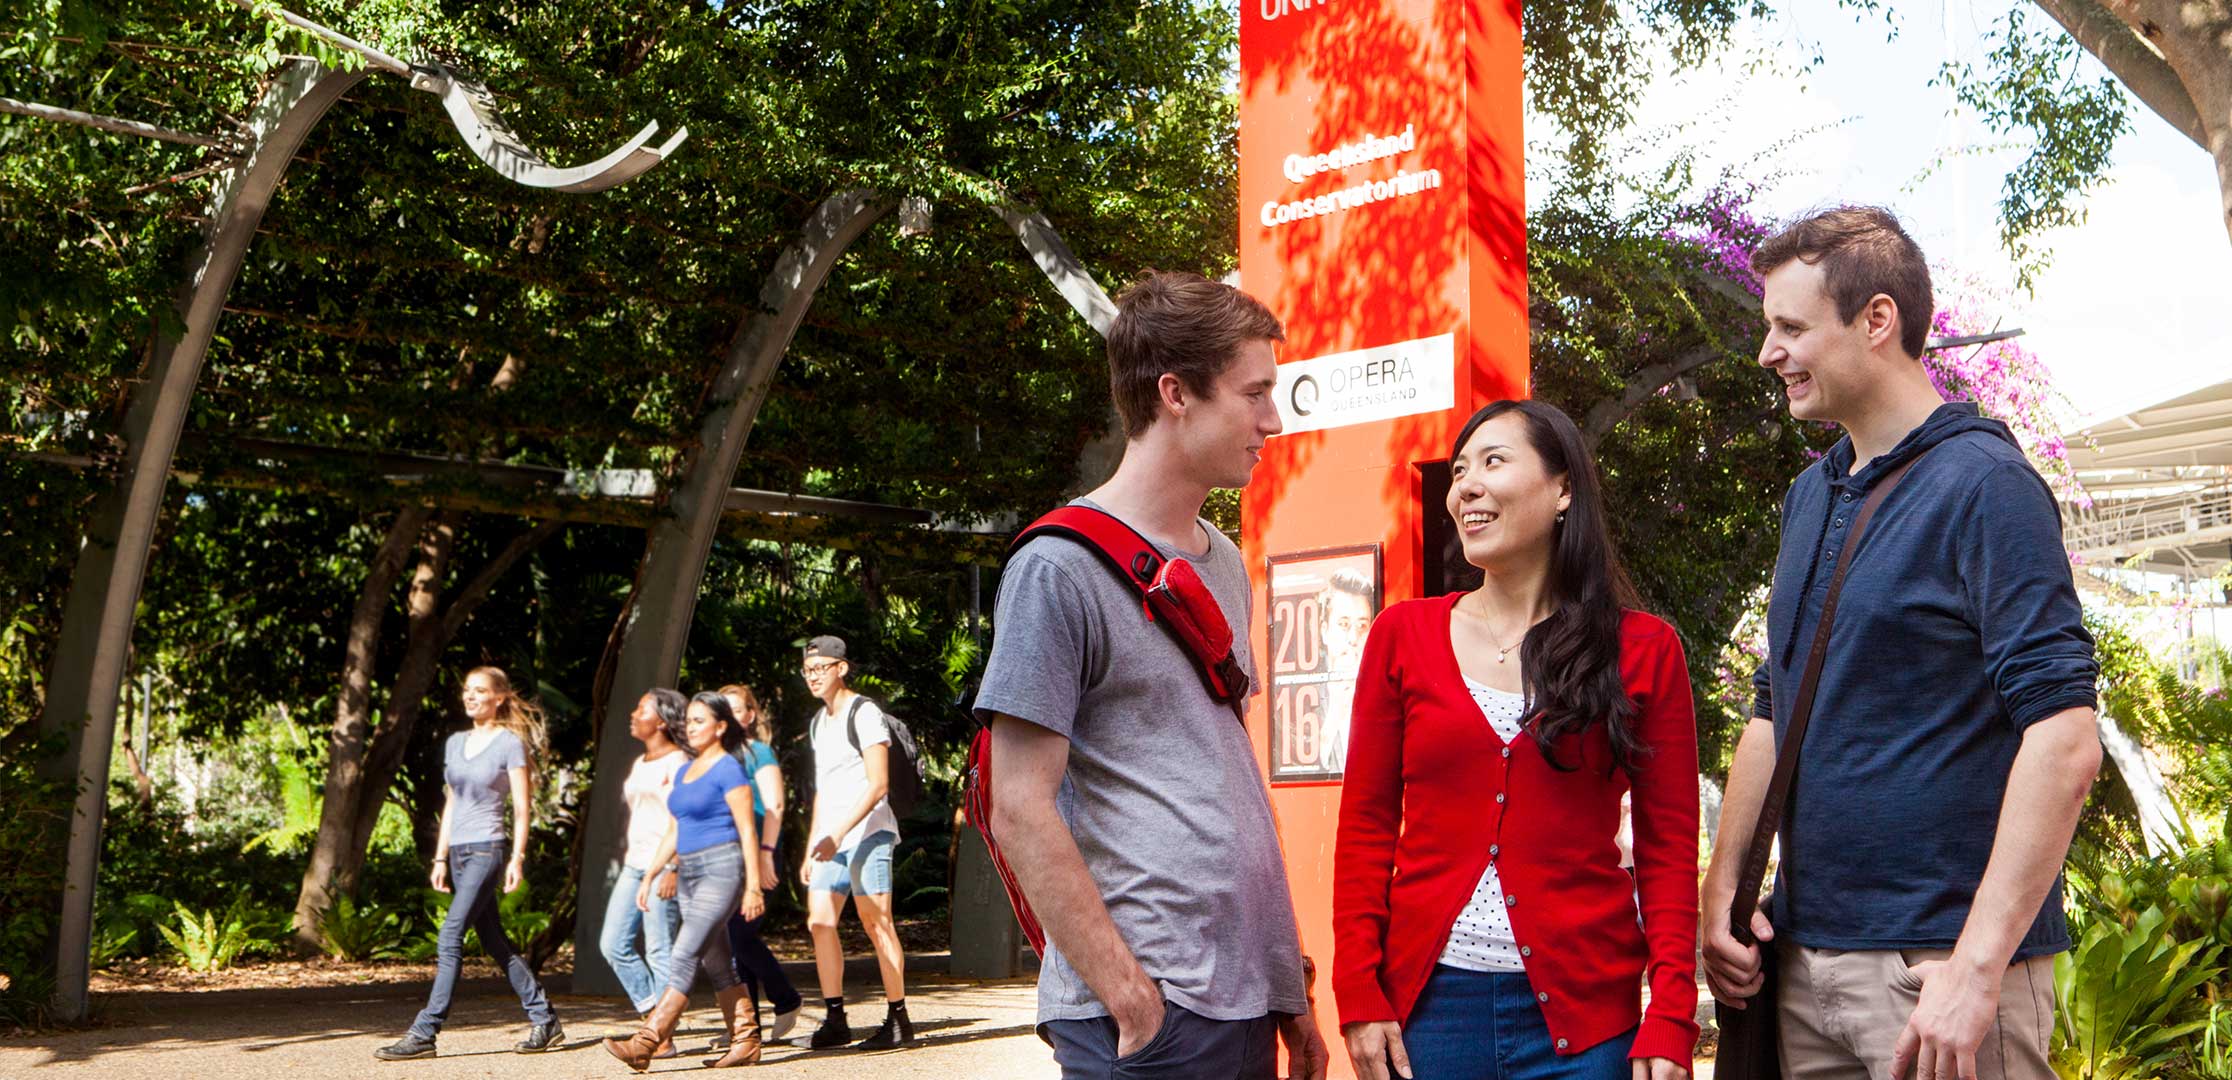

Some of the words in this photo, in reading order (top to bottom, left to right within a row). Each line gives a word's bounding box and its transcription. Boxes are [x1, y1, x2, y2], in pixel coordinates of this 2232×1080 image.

[1283, 123, 1415, 184] Queensland
[1260, 168, 1441, 228] Conservatorium
[1330, 357, 1414, 392] OPERA
[1332, 387, 1416, 411] QUEENSLAND
[1274, 599, 1319, 672] 20
[1276, 686, 1320, 765] 16
